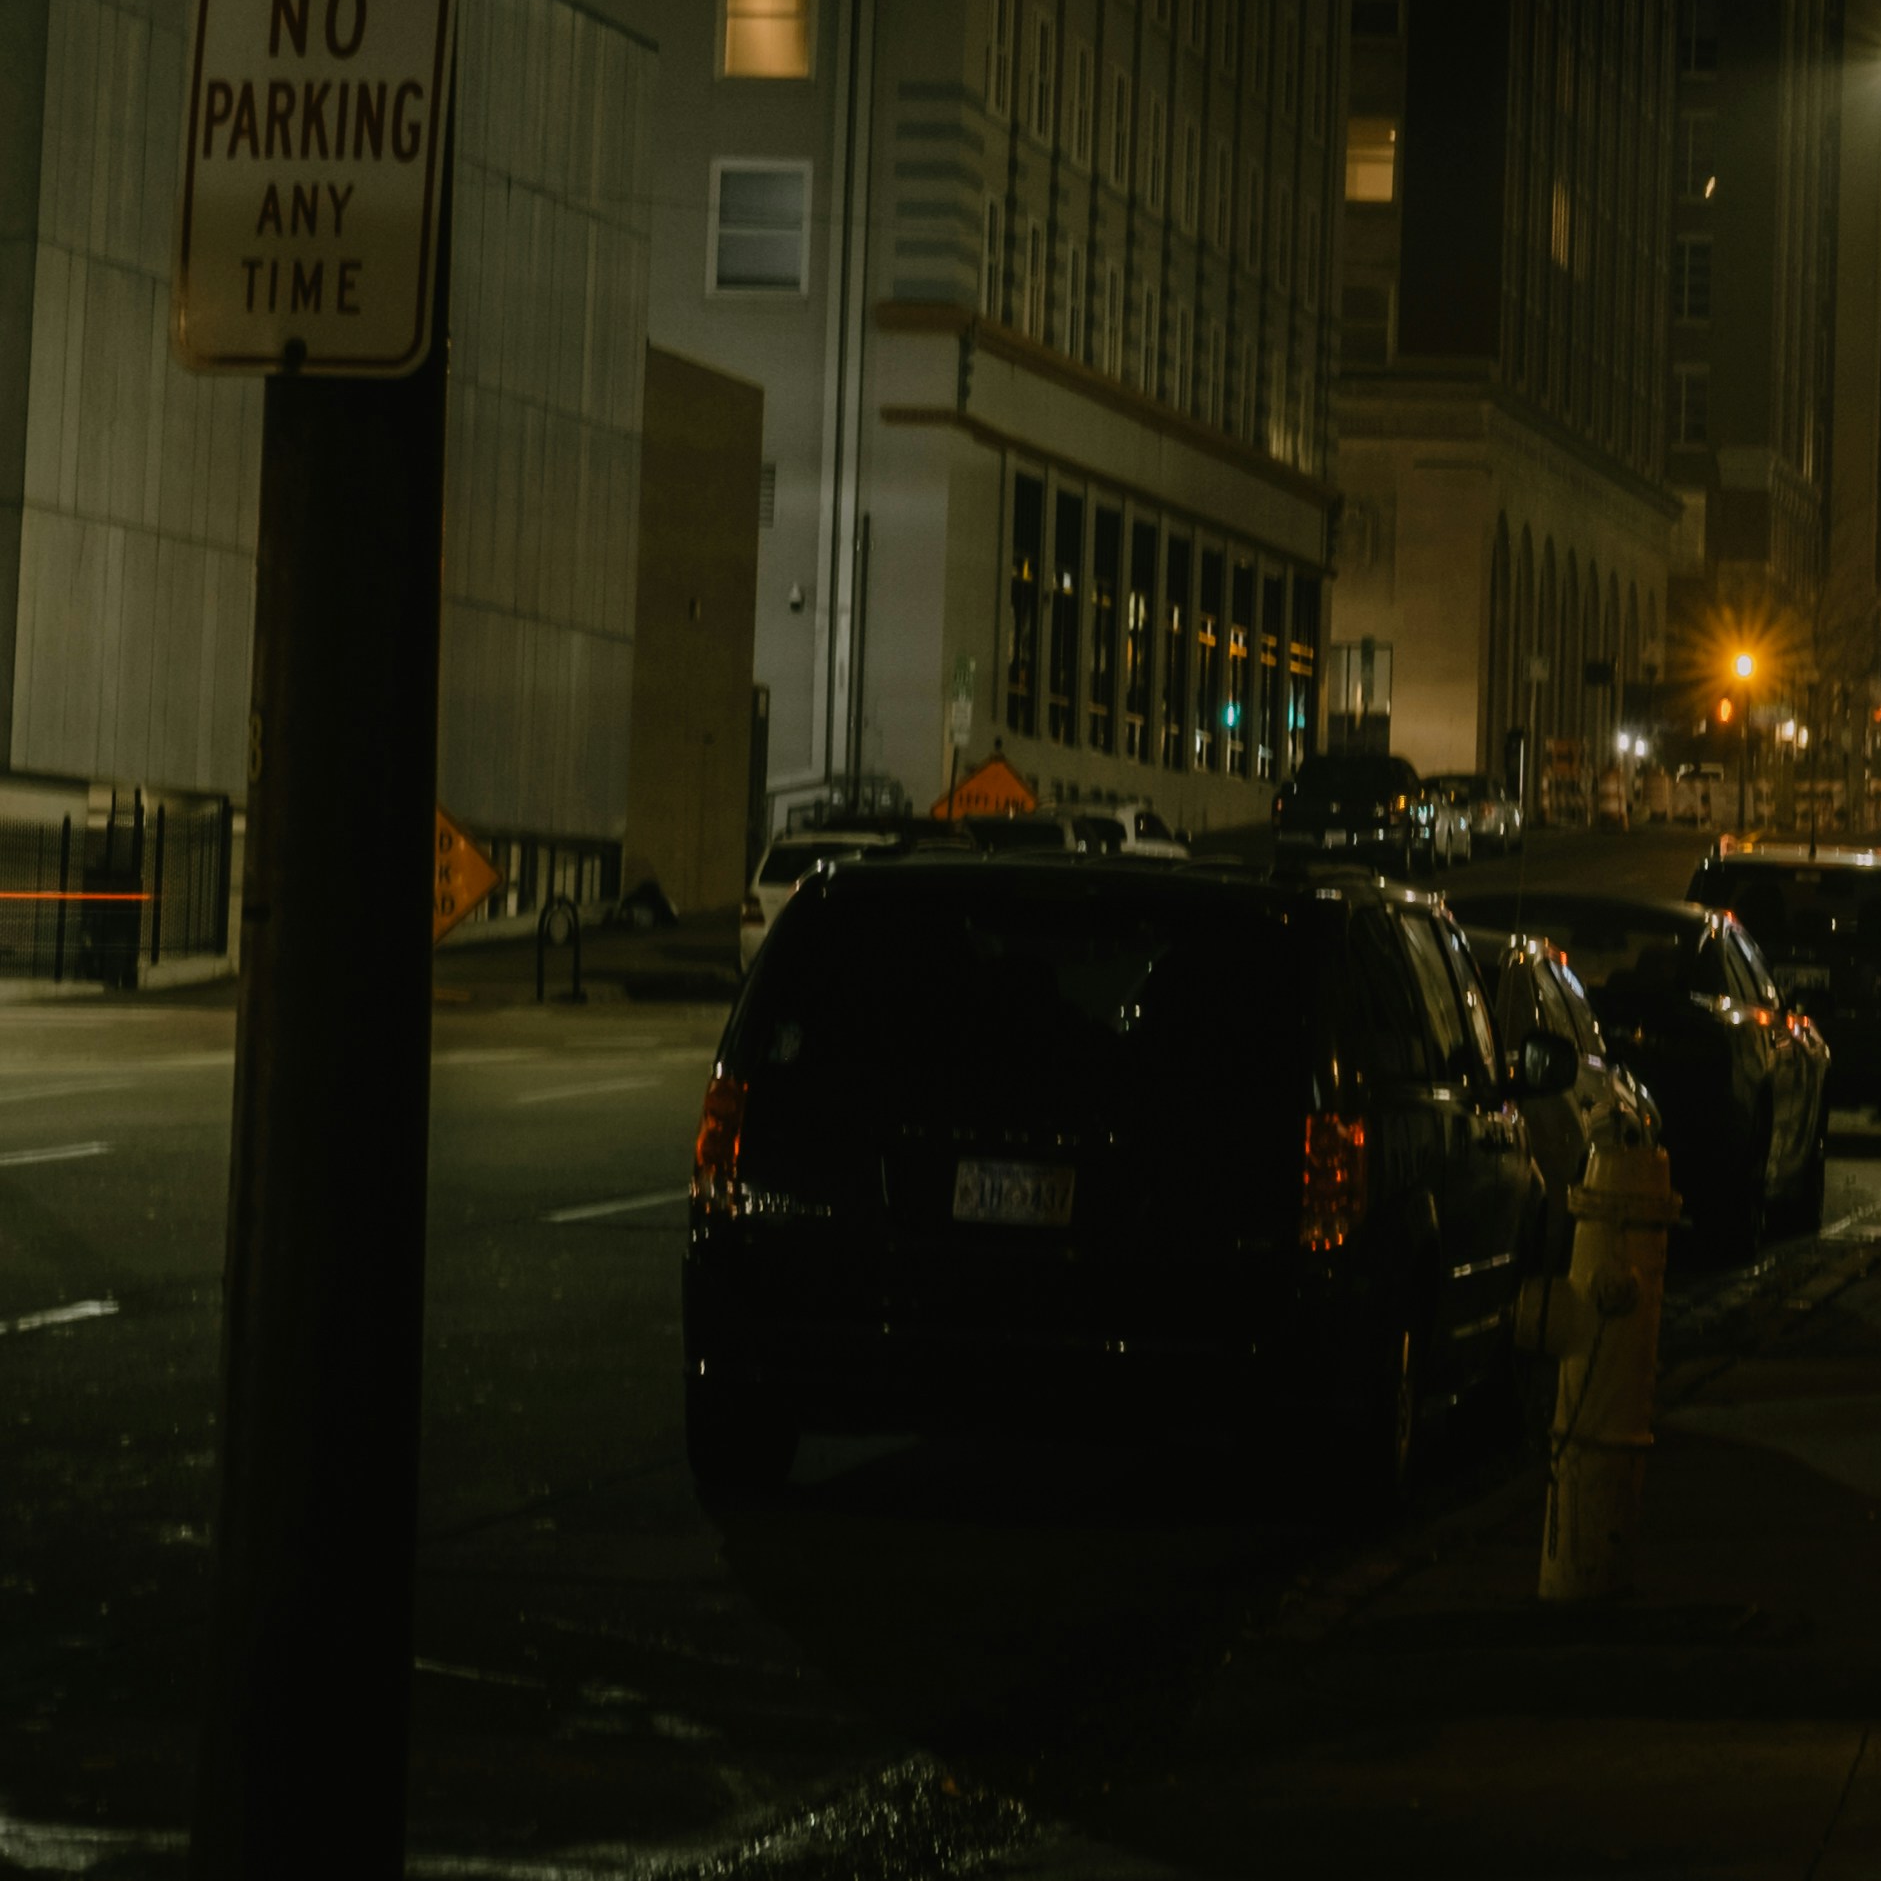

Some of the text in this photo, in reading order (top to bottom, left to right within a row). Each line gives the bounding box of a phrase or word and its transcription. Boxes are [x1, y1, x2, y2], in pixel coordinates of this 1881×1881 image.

[202, 79, 425, 163] PARKING
[256, 184, 355, 238] ANY
[241, 259, 363, 316] TIME
